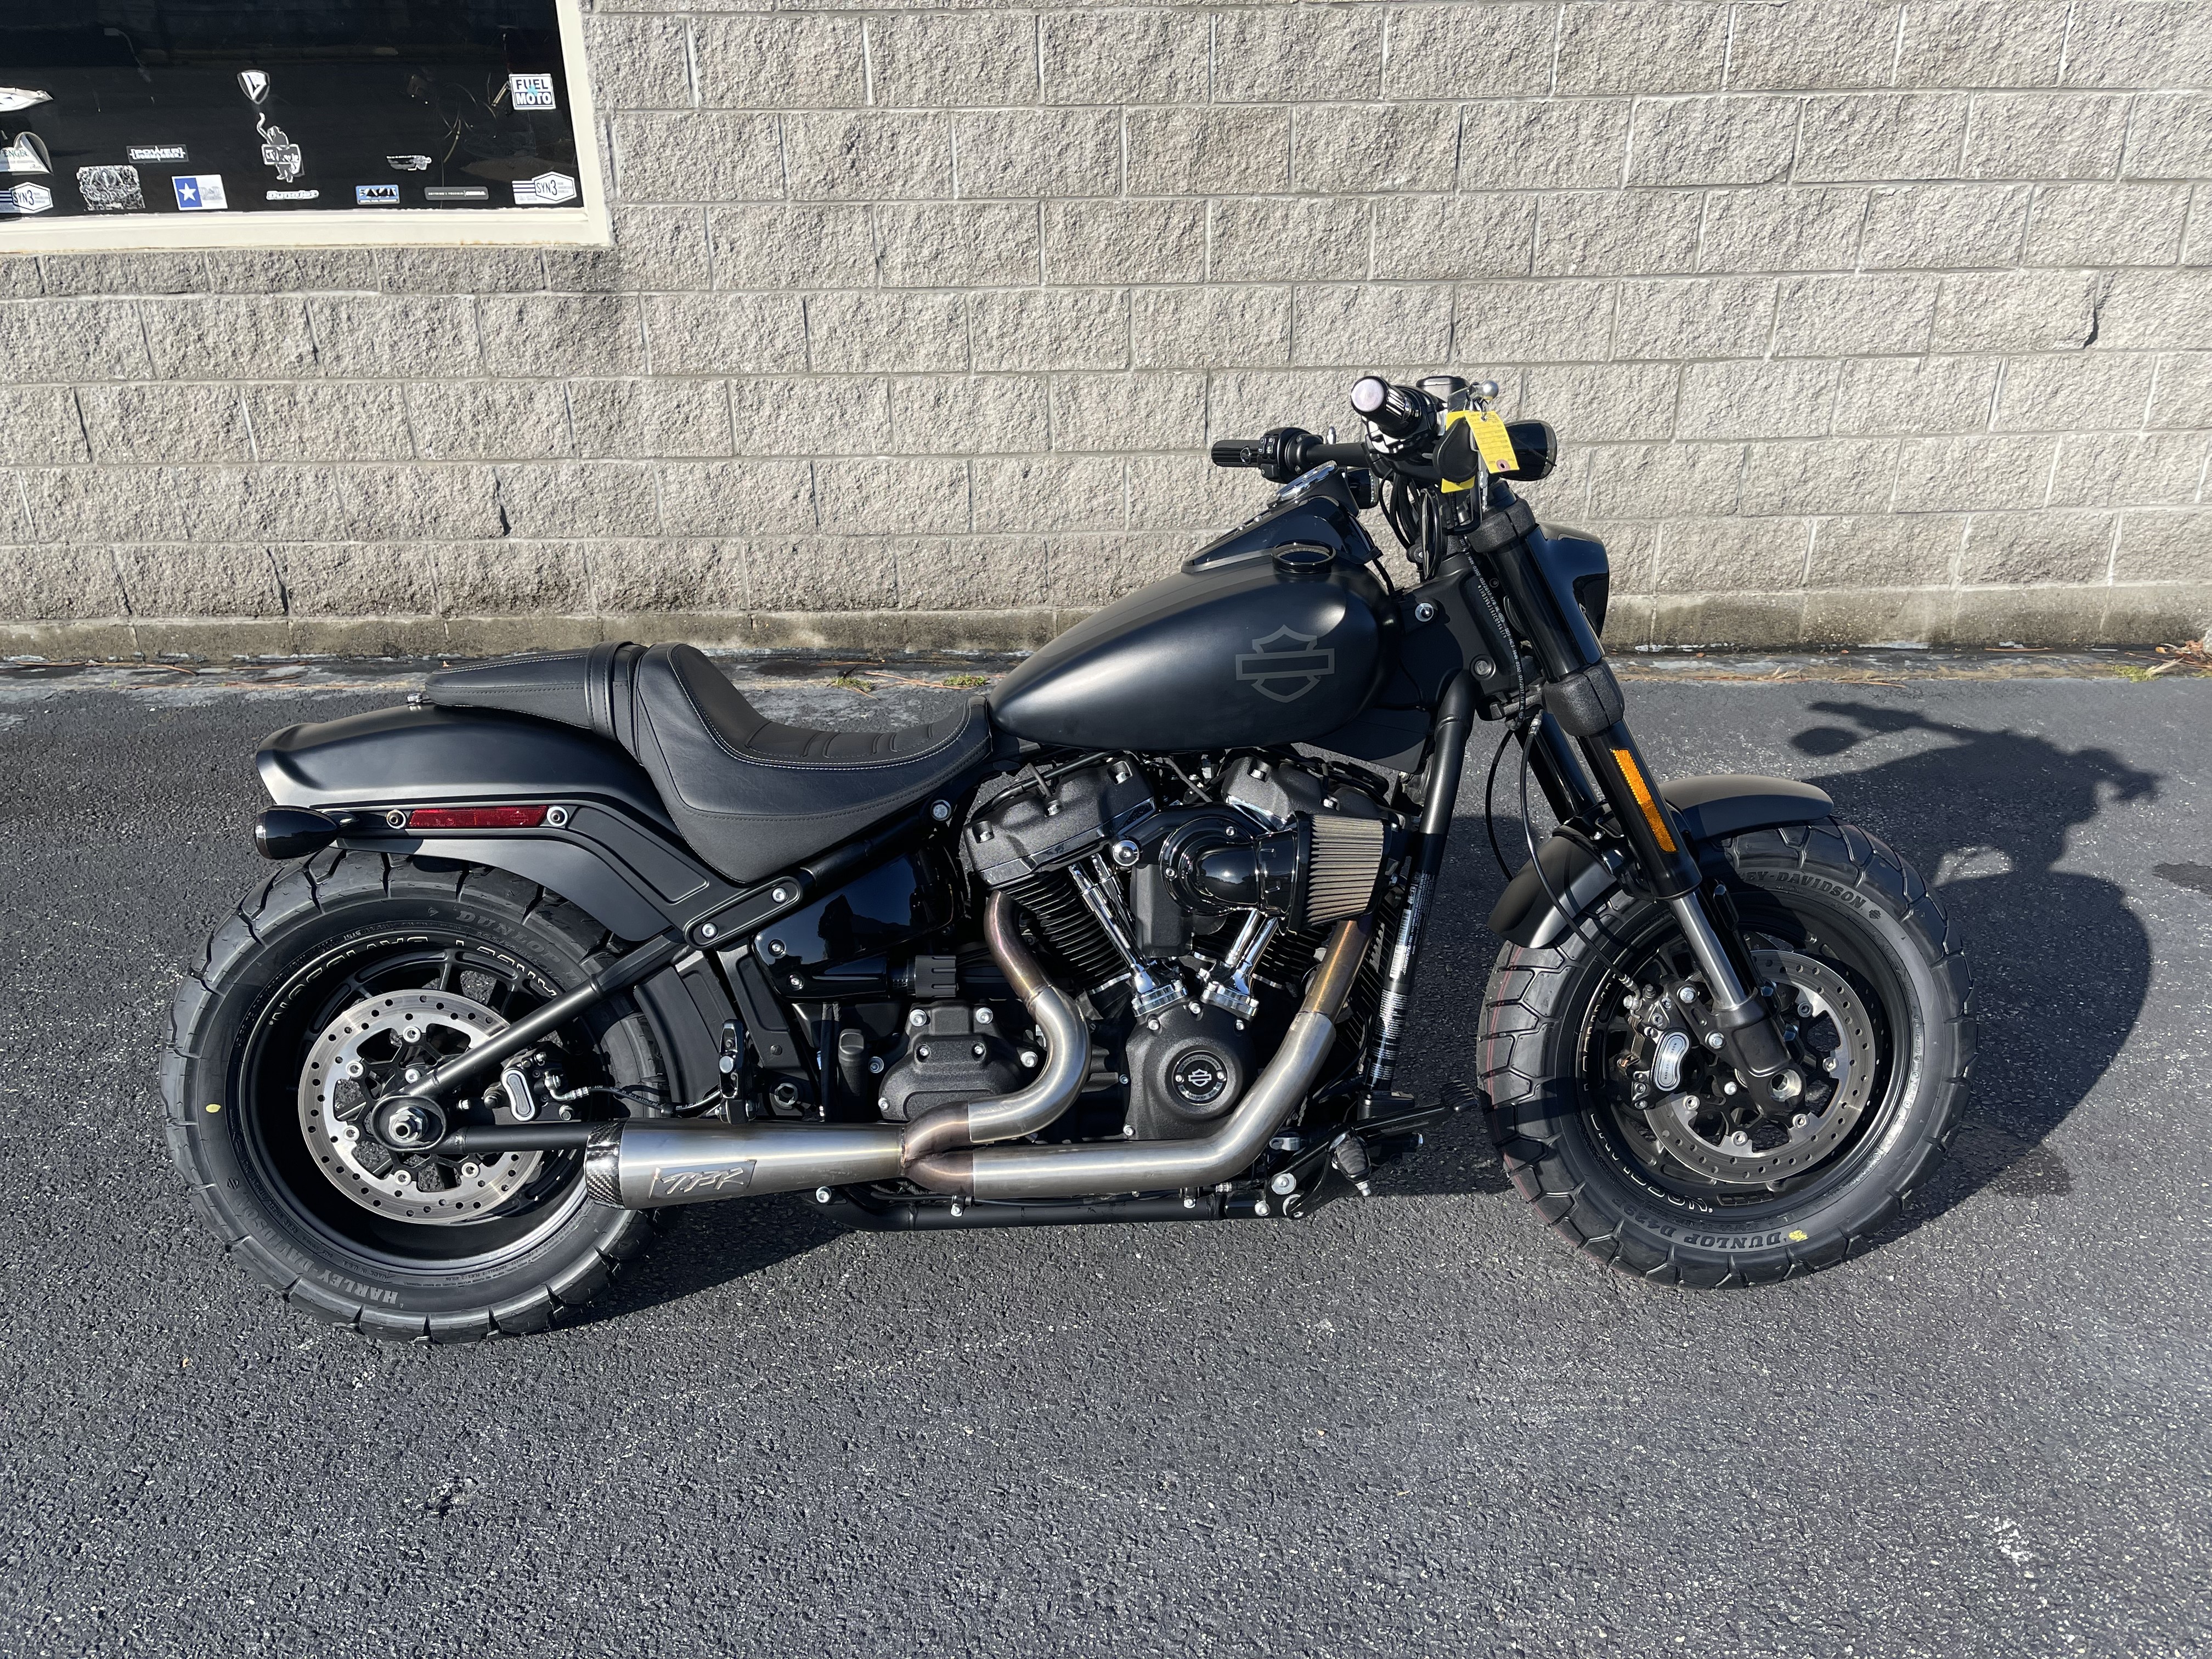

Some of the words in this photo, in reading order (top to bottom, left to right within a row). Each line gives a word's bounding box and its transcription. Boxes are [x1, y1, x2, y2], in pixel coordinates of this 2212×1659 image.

[516, 79, 548, 90] FUEL
[516, 92, 552, 105] MOTO
[456, 910, 562, 963] DUNLOP
[1683, 1232, 1782, 1250] DUNLOP
